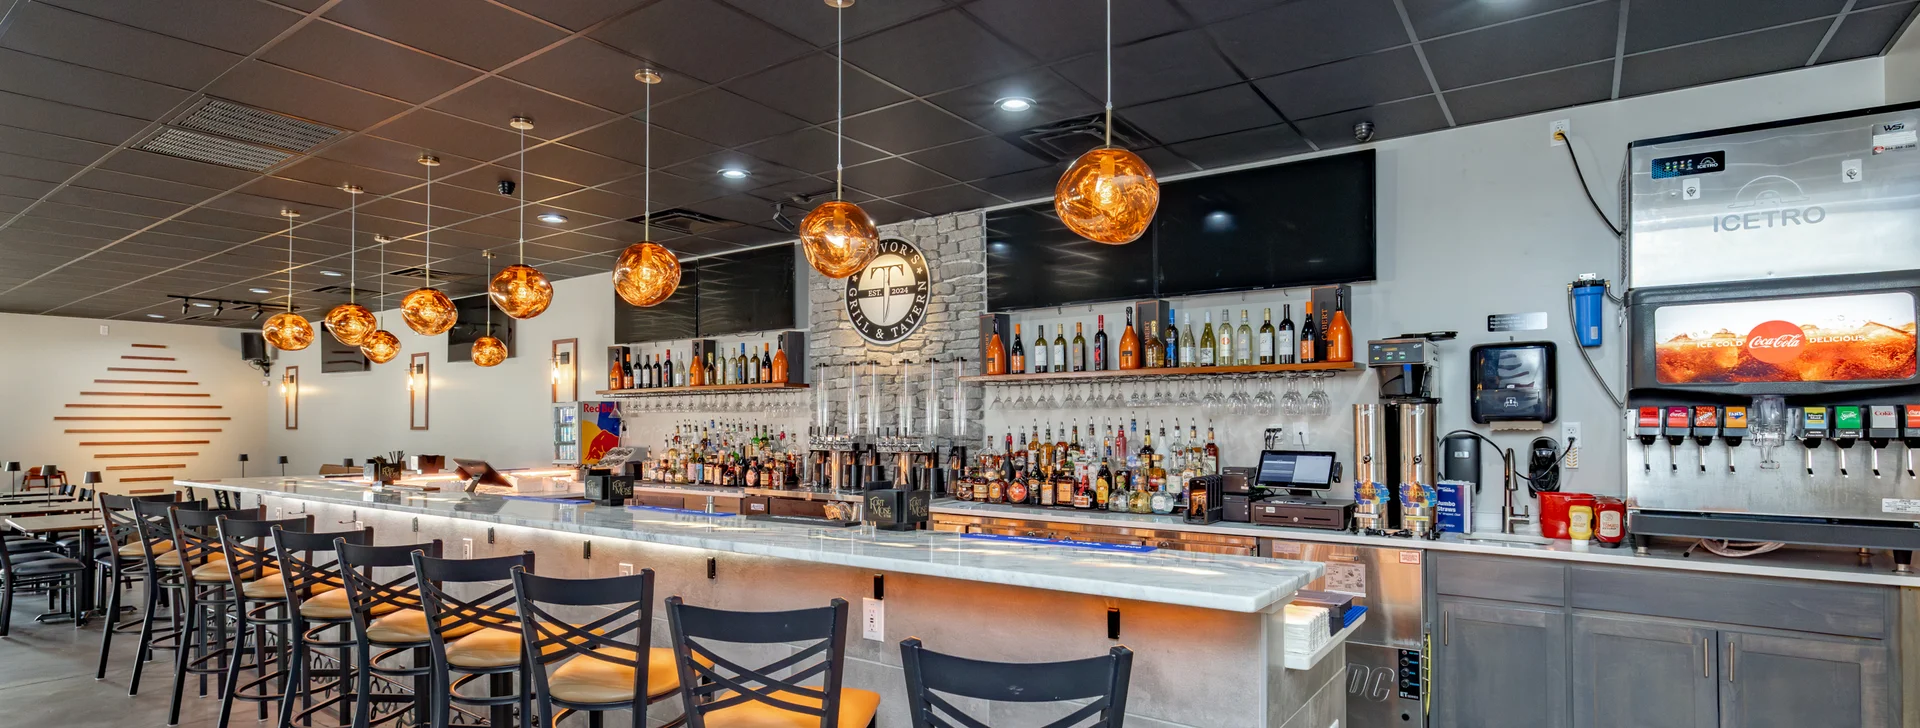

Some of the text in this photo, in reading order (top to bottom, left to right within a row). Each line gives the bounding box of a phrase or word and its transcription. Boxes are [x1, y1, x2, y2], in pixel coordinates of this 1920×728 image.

[1713, 205, 1826, 232] ICETRO
[868, 287, 909, 297] EST. 2024
[848, 280, 927, 339] GRILL & TAVERN
[1697, 340, 1743, 348] ICE COLD
[1749, 334, 1802, 349] Coca-Cola
[1809, 335, 1865, 343] DELICIOUS
[583, 403, 600, 413] Red
